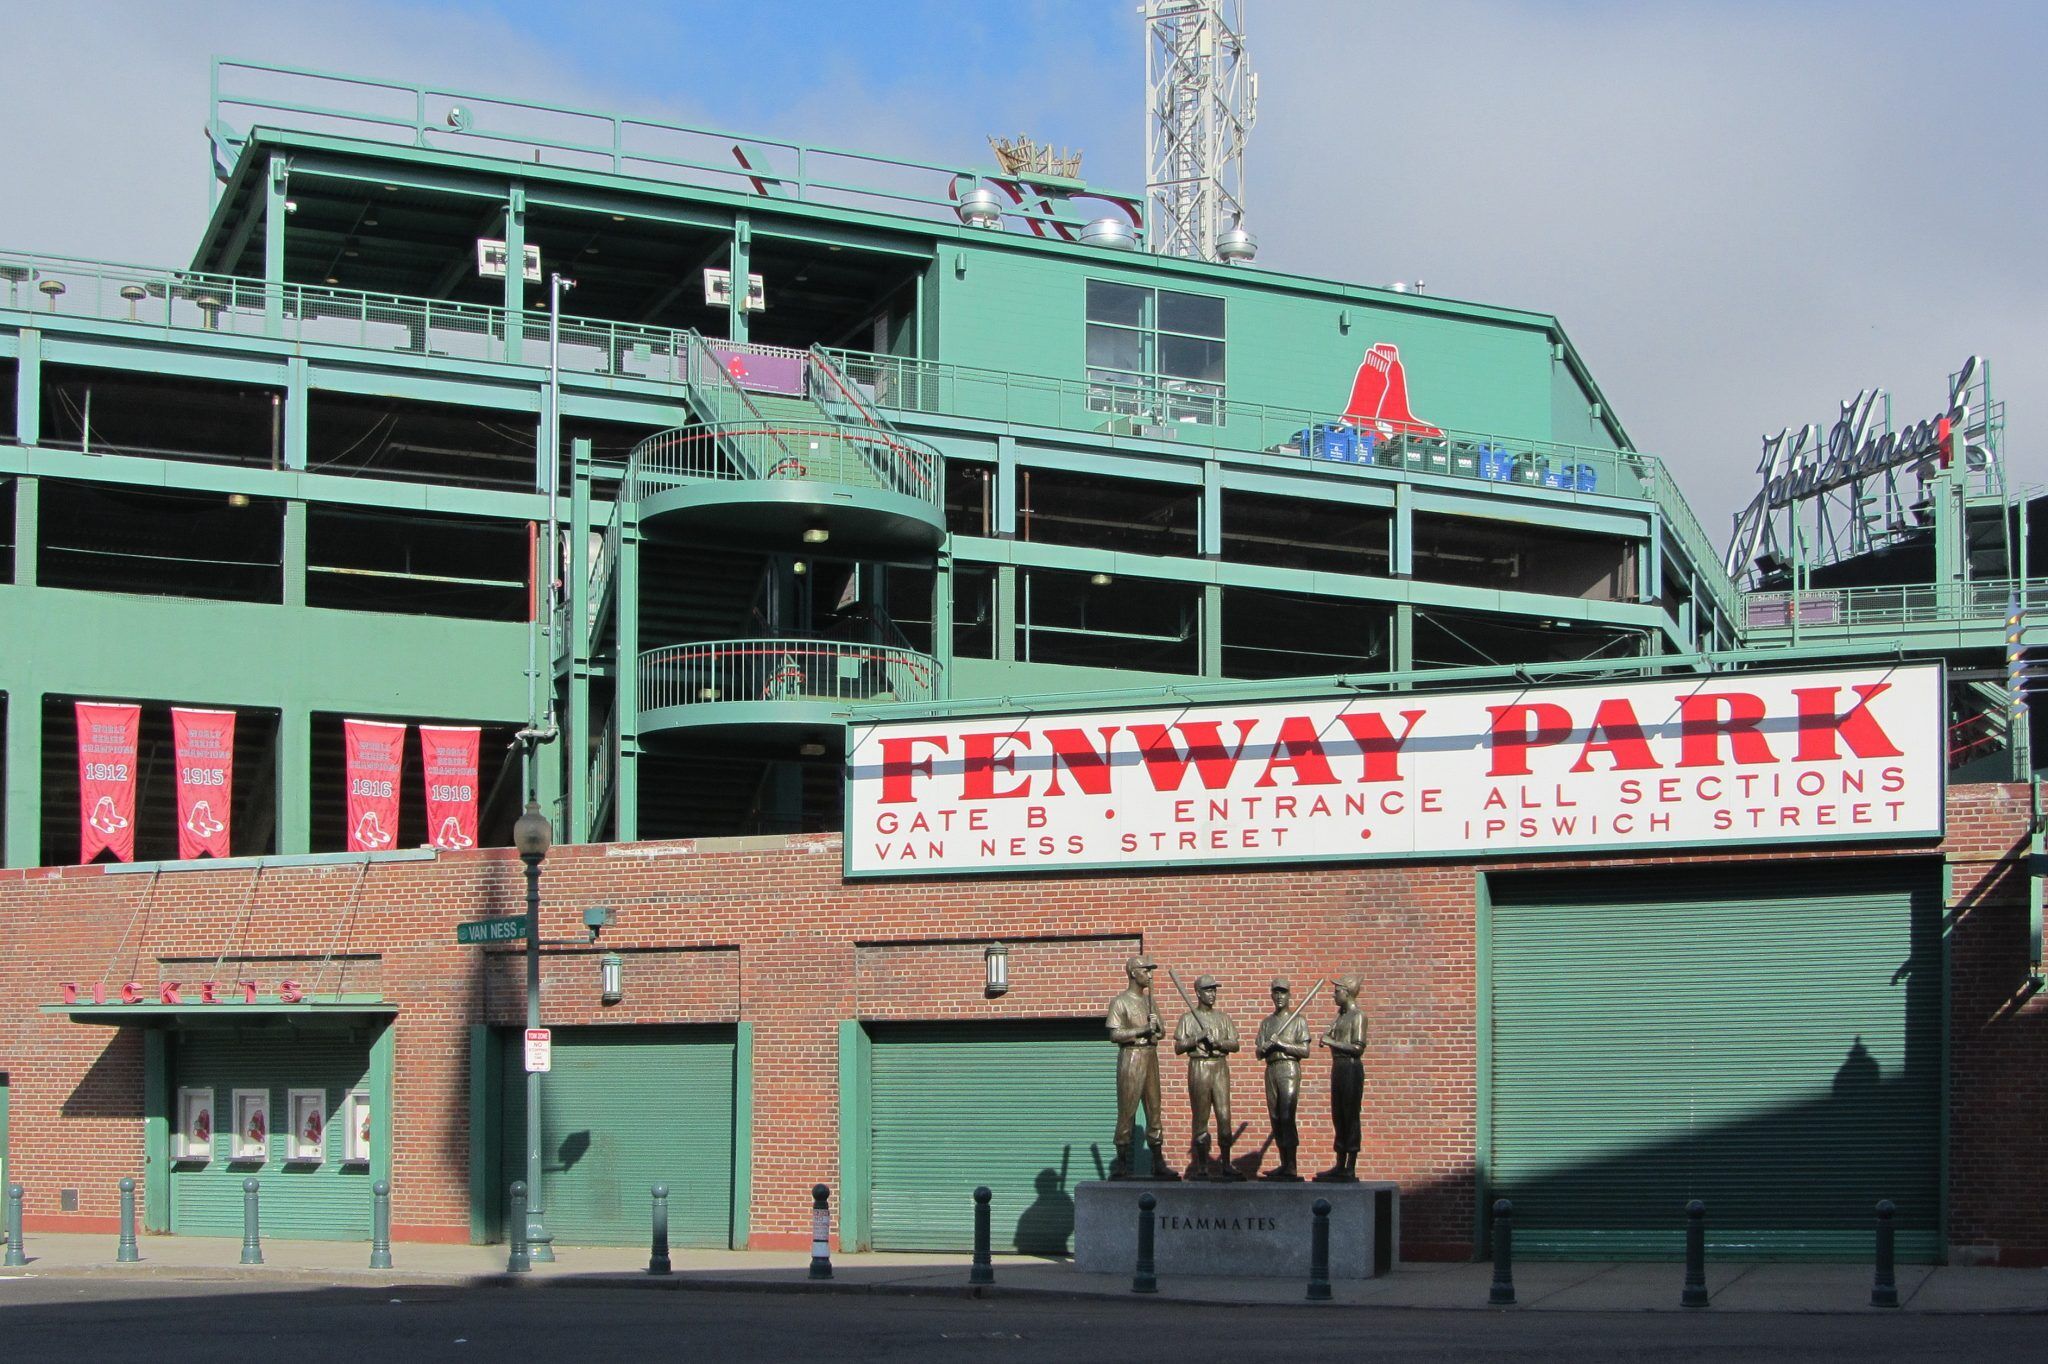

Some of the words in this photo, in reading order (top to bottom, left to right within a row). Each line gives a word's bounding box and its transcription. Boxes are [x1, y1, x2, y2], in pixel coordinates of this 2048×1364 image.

[1725, 422, 1822, 582] John
[877, 710, 1427, 805] FENWAY
[1486, 683, 1905, 779] PARK
[86, 762, 128, 782] 1912
[182, 767, 224, 786] 1915
[352, 778, 393, 798] 1916
[431, 785, 472, 802] 1918
[876, 808, 989, 835] GATE
[1027, 806, 1048, 829] B
[1174, 788, 1442, 824] ENTRANCE
[1484, 783, 1578, 809] ALL
[1620, 767, 1905, 805] SECTIONS
[1465, 813, 1672, 842] IPSWICH
[1715, 800, 1905, 831] STREET
[875, 840, 944, 861] VAN
[981, 834, 1085, 857] NESS
[1121, 827, 1289, 853] STREET
[468, 924, 488, 940] VAN
[490, 922, 517, 939] NESS
[59, 981, 304, 1005] TICKETS
[1159, 1215, 1277, 1231] TEAMMATES
